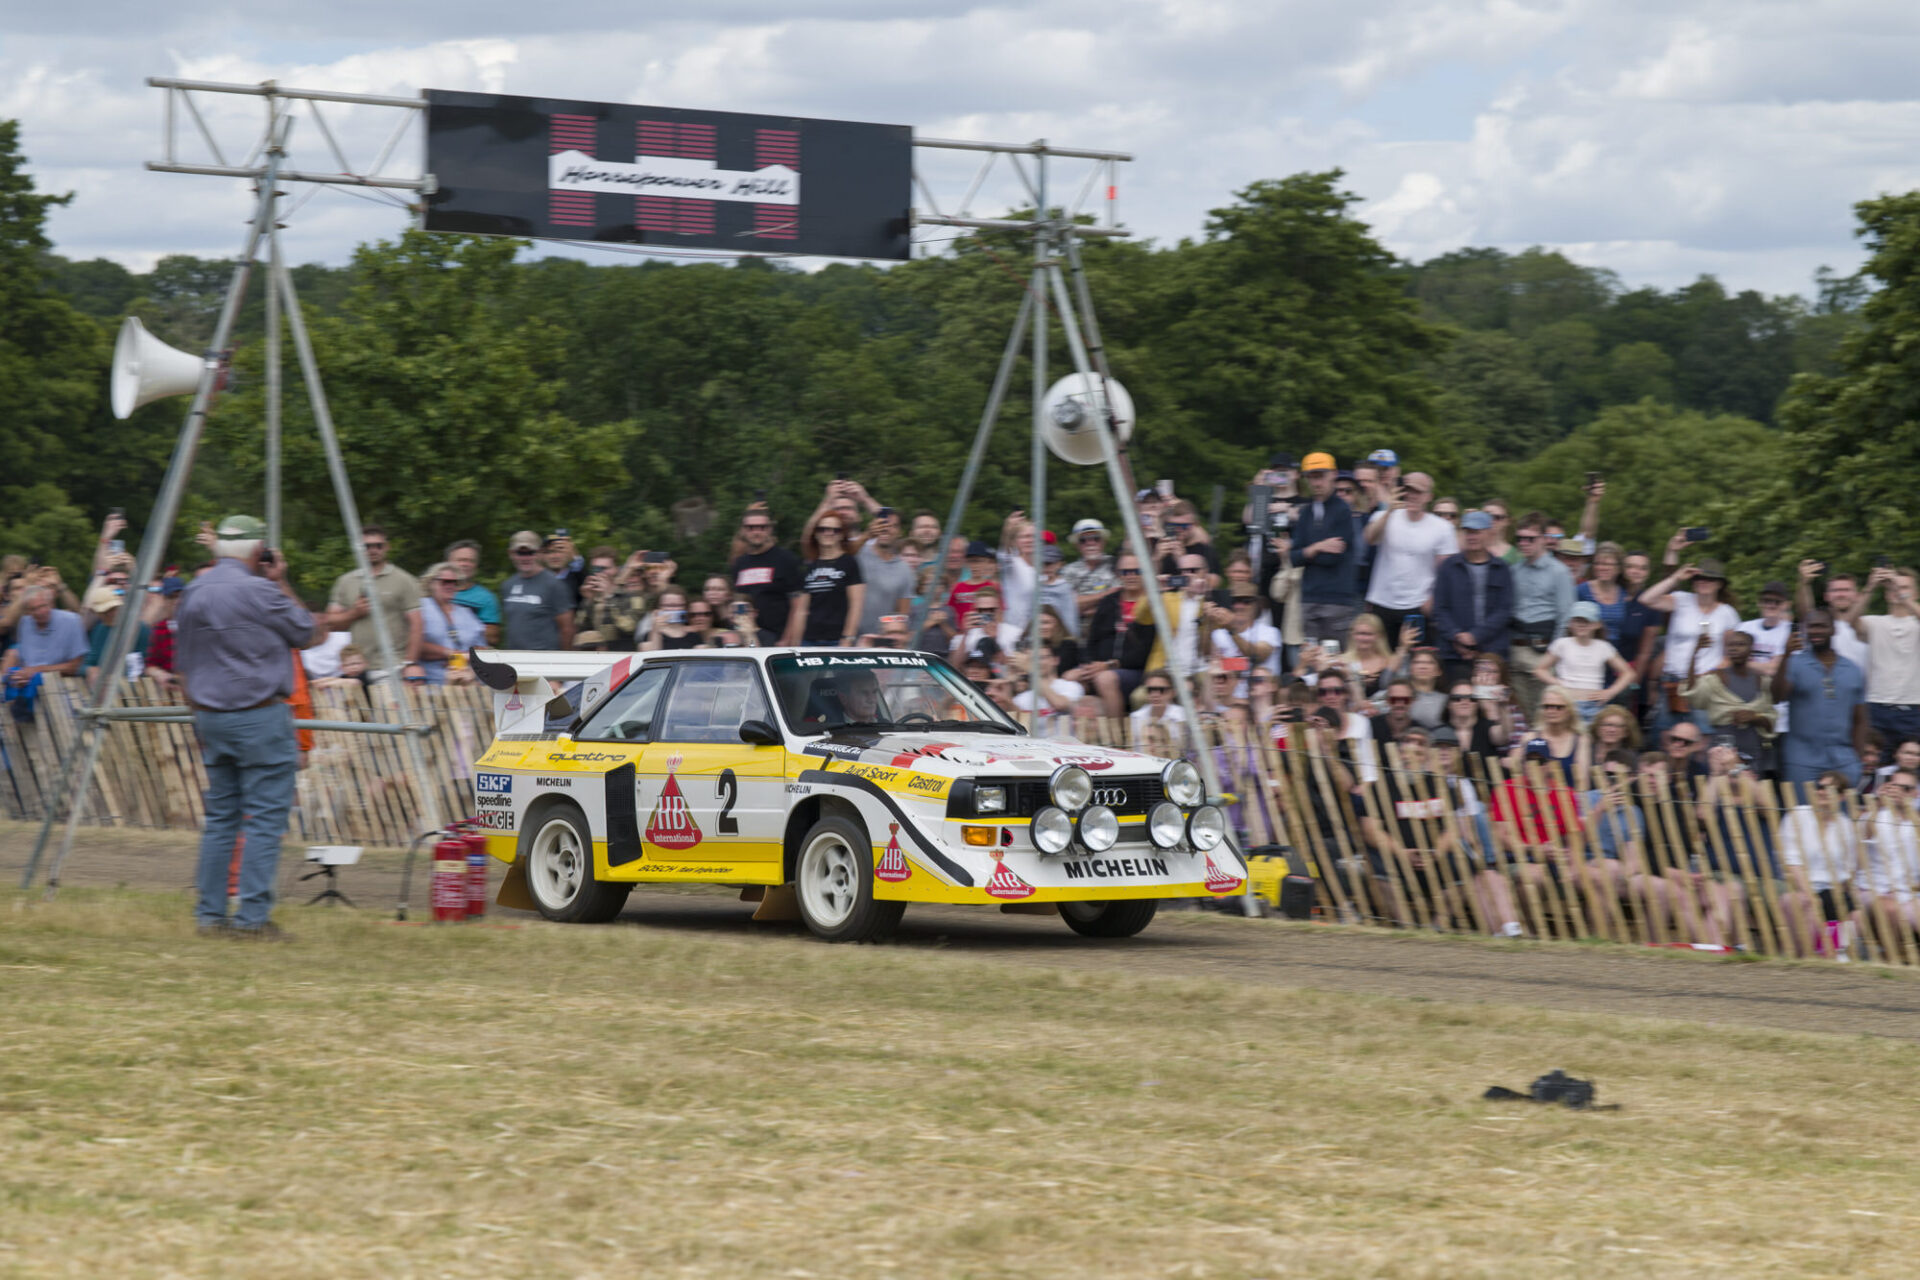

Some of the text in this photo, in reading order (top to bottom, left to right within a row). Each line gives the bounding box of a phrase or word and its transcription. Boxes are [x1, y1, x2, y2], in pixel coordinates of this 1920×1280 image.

[559, 164, 793, 197] Horsepower Hill
[796, 657, 824, 667] HB
[878, 656, 928, 667] TEAM
[548, 752, 627, 763] quattro
[536, 777, 572, 787] MICHELIN
[844, 765, 898, 783] Audi Sport
[478, 775, 511, 791] SKF
[907, 775, 947, 793] Castrol
[477, 794, 512, 807] speedline
[714, 768, 740, 837] 2
[657, 795, 687, 830] HB
[653, 832, 696, 843] international
[882, 848, 903, 871] HB
[638, 865, 678, 873] BOSCH
[1063, 858, 1169, 879] MICHELIN
[1207, 866, 1230, 882] HB
[991, 872, 1022, 888] HB
[991, 888, 1030, 896] international
